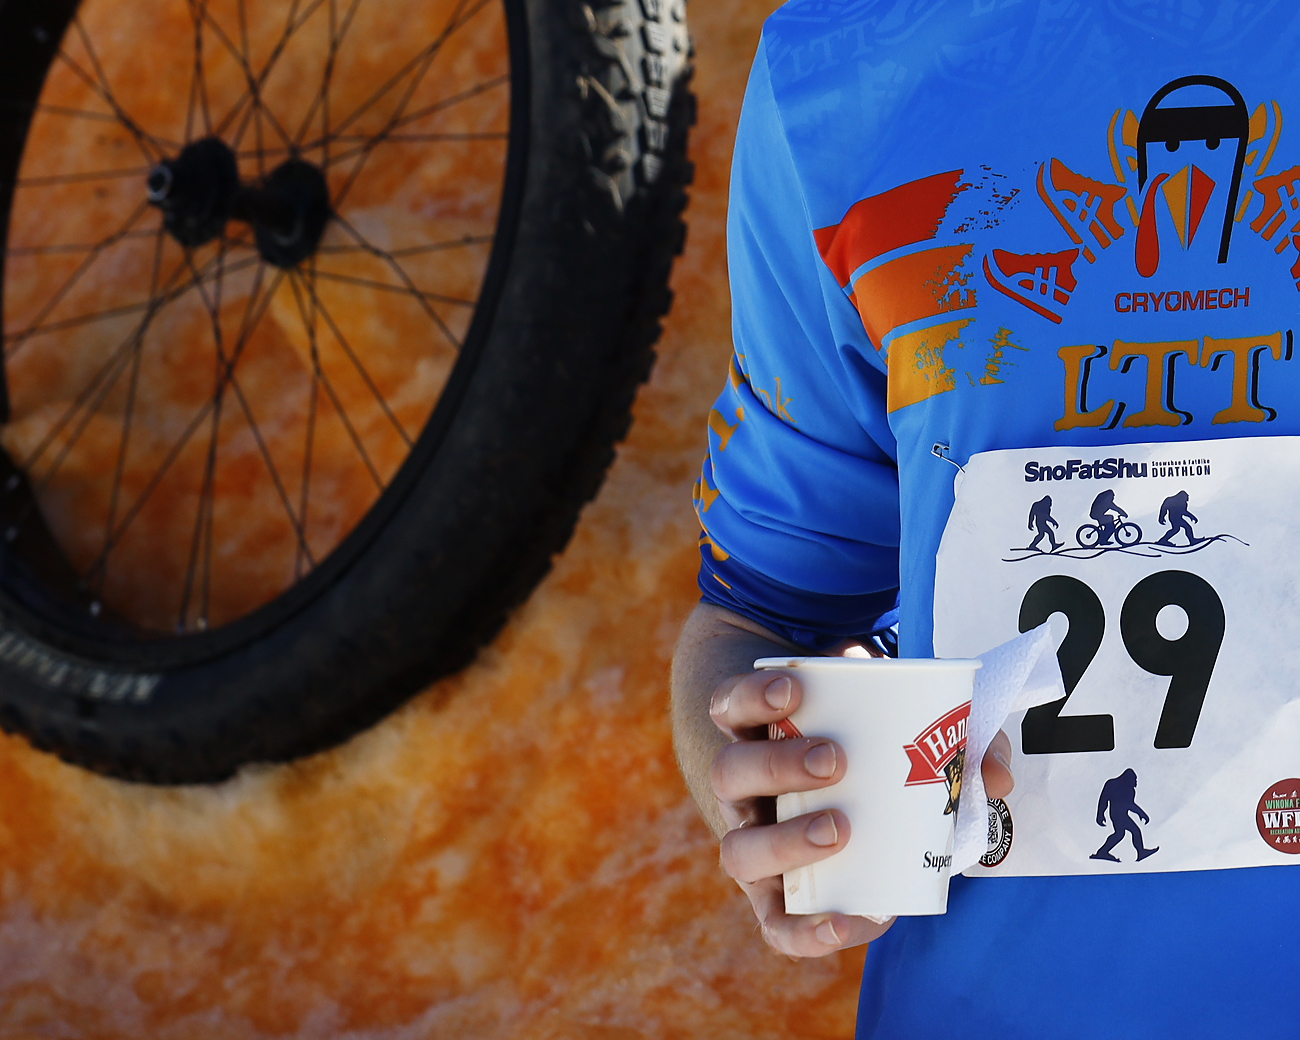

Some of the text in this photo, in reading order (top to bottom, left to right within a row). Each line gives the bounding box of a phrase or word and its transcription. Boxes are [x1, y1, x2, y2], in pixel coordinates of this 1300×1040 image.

[1114, 286, 1250, 313] CRYOMECH
[1024, 458, 1148, 482] SnoFatShu
[1151, 464, 1211, 478] DUATHLON
[1018, 569, 1226, 755] 29
[1265, 799, 1294, 809] WINONA
[987, 831, 1012, 865] COMPANY
